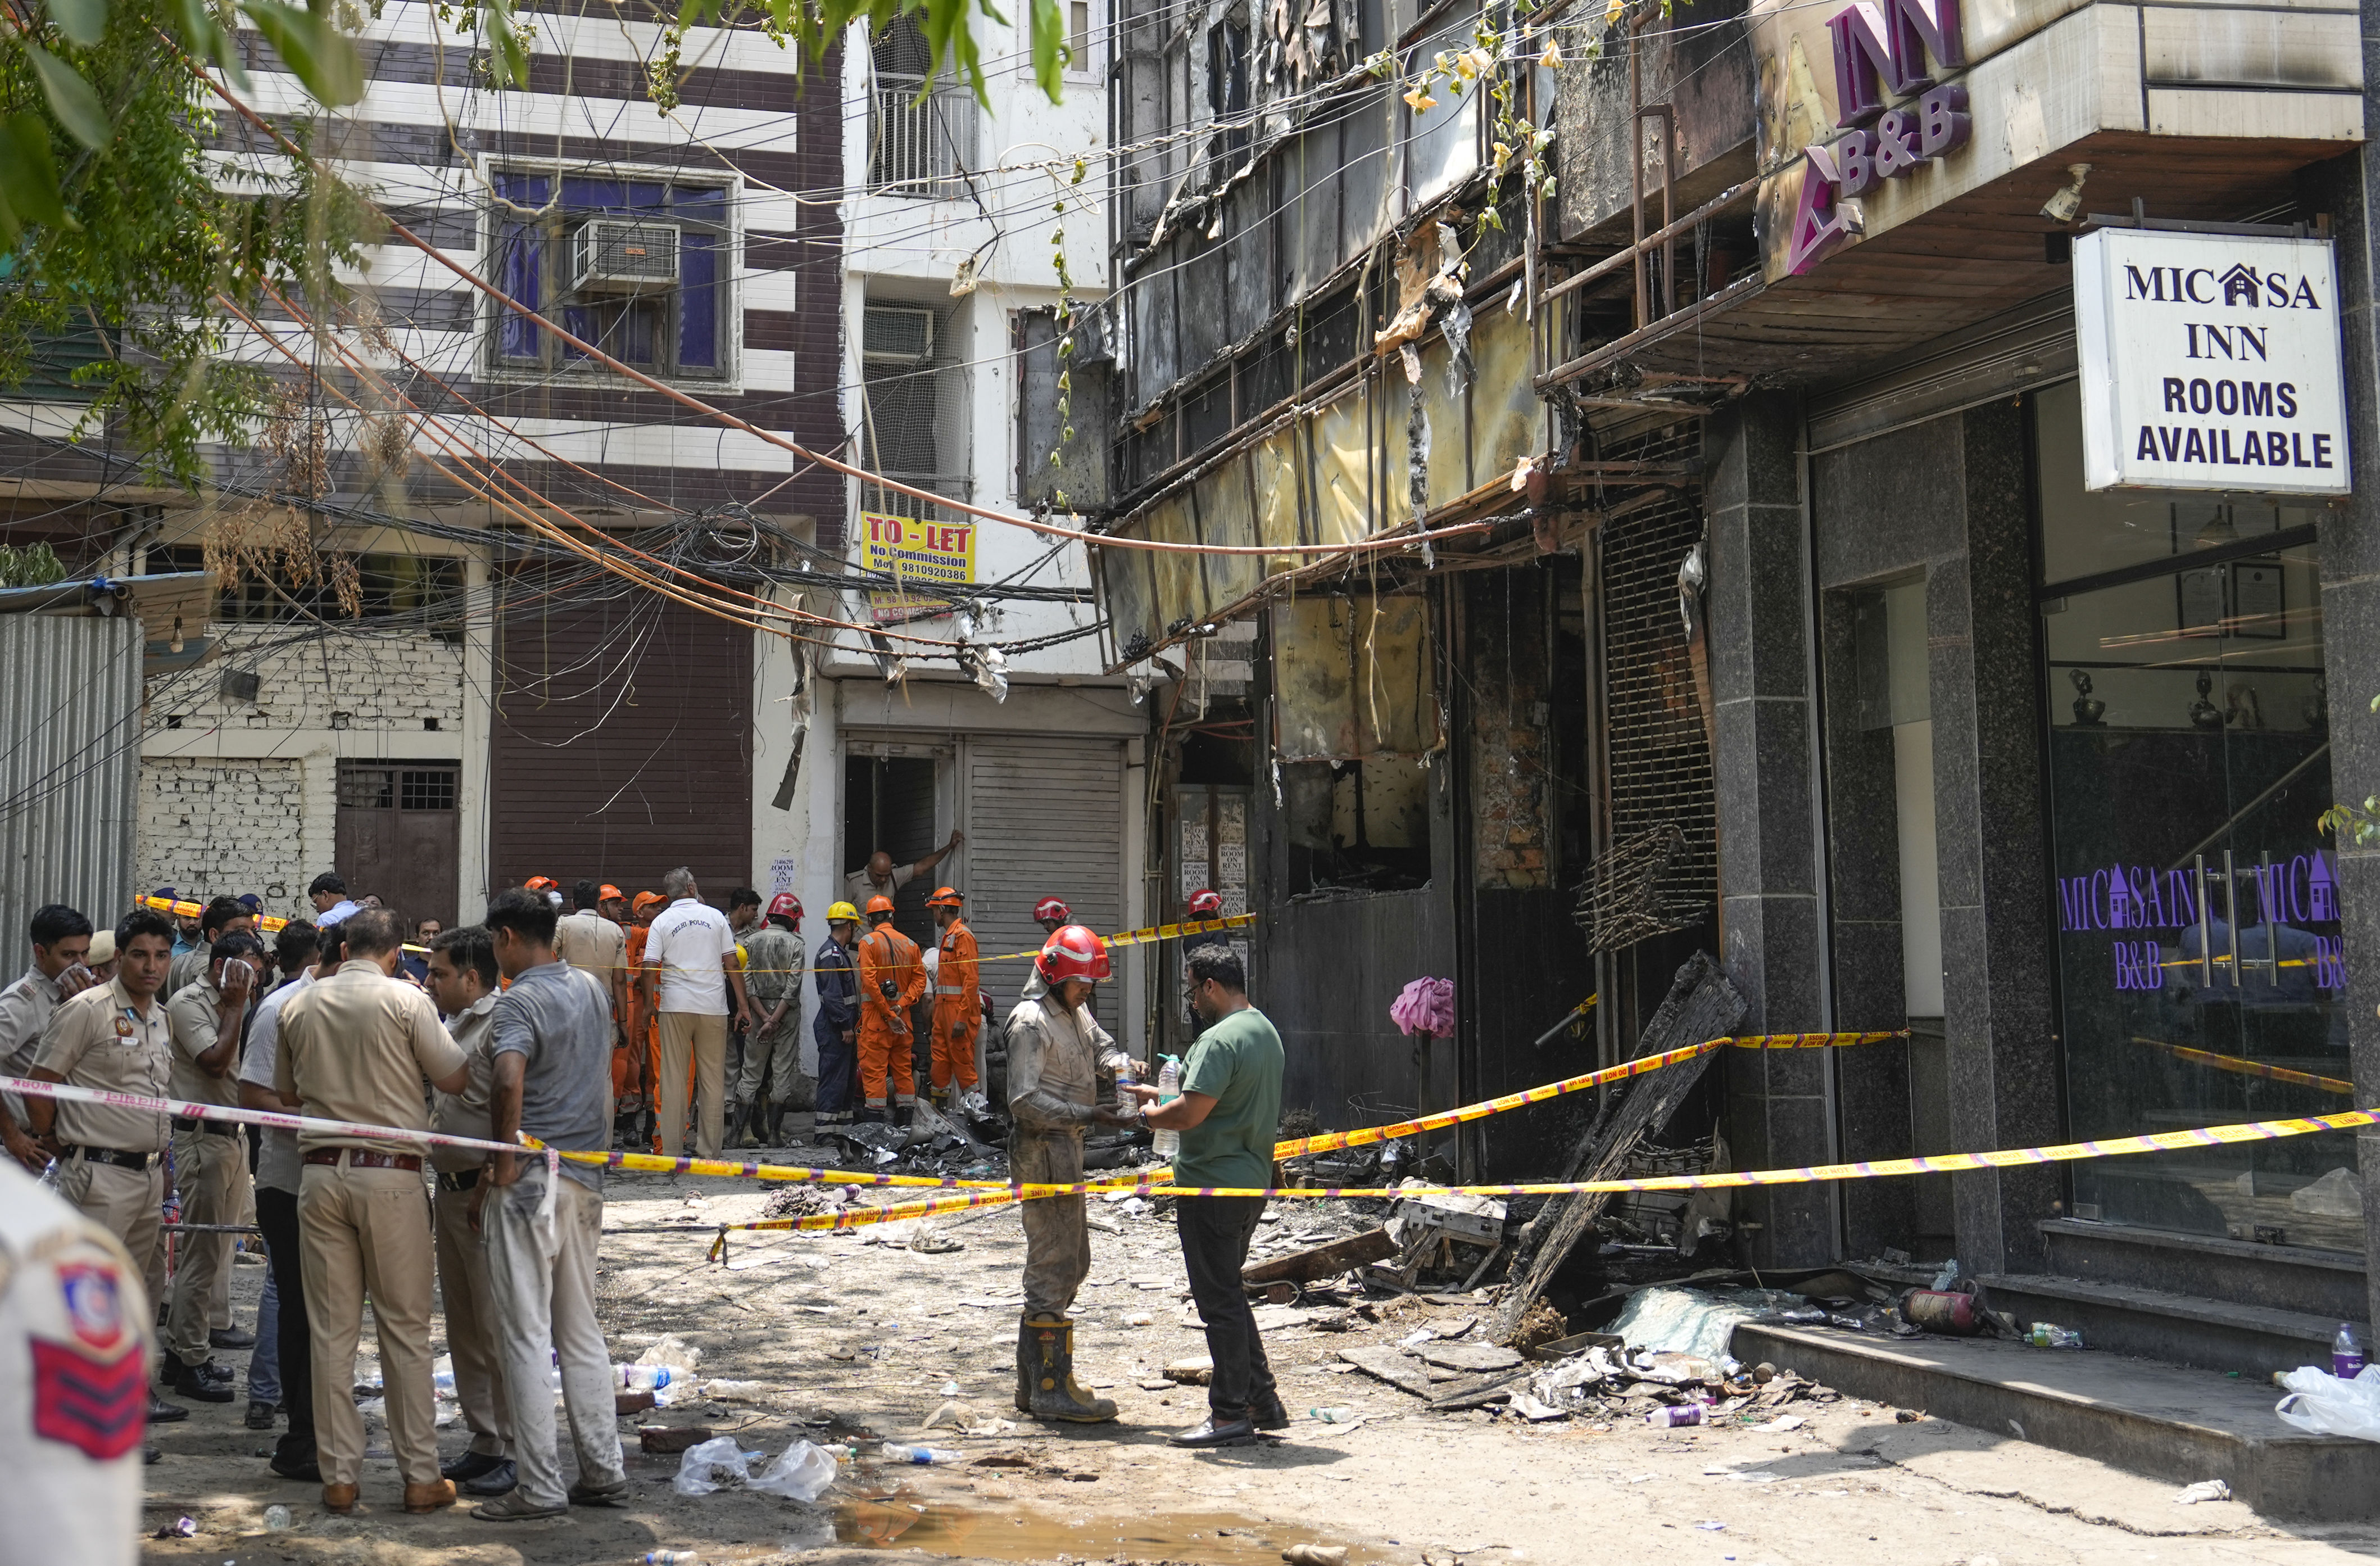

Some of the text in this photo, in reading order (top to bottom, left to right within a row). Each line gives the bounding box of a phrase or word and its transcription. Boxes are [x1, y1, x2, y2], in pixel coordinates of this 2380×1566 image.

[1838, 84, 1972, 199] B&B
[2184, 323, 2268, 363] INN
[2163, 377, 2297, 418] ROOMS
[2137, 424, 2333, 469] AVAILABLE
[866, 516, 902, 544] TO
[927, 525, 971, 553] LET
[871, 544, 966, 567] No Commission
[901, 562, 965, 581] 9810920386
[877, 609, 888, 617] NO
[672, 920, 711, 938] DELHI POLICE
[2113, 940, 2163, 990] B&B
[1604, 1068, 1627, 1080] DO NOT
[12, 1078, 53, 1092] WORK
[1569, 1076, 1590, 1087] DELHI
[1424, 1116, 1450, 1127] POLICE
[2339, 1116, 2363, 1125] LINE
[1312, 1137, 1335, 1146] DELHI
[2047, 1148, 2080, 1157] DELHI
[981, 1196, 1010, 1204] POLICE
[850, 1208, 881, 1217] POLICE
